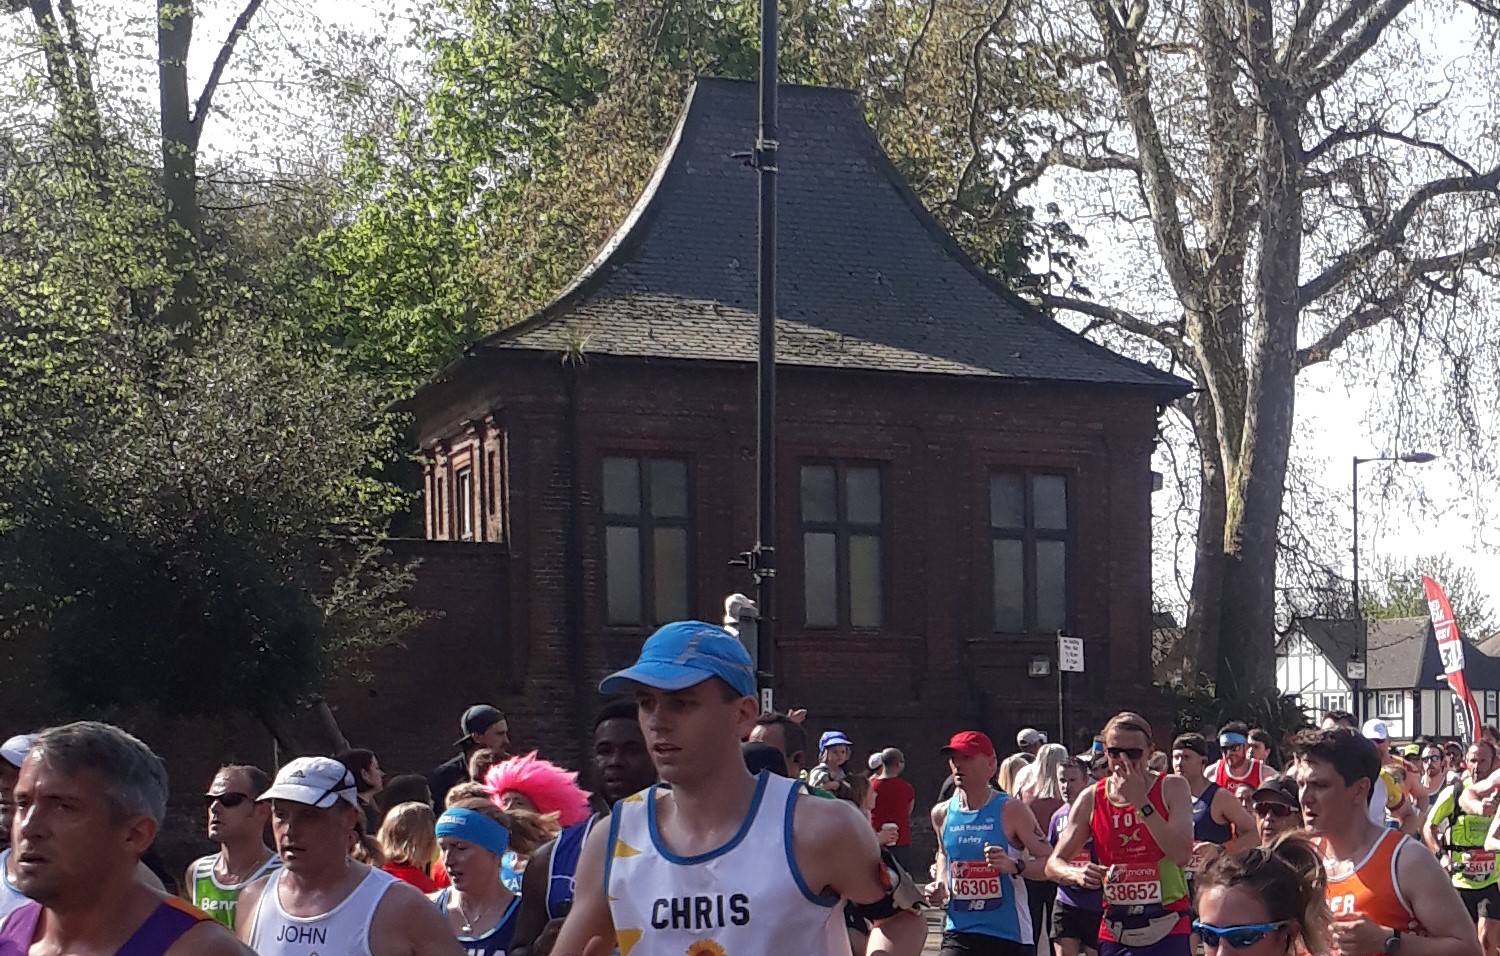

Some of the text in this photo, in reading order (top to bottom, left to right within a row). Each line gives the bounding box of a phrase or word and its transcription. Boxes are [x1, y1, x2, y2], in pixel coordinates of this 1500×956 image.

[953, 879, 999, 896] 46306
[1106, 883, 1159, 902] 38652
[651, 893, 750, 930] CHRIS
[277, 924, 327, 945] JOHN
